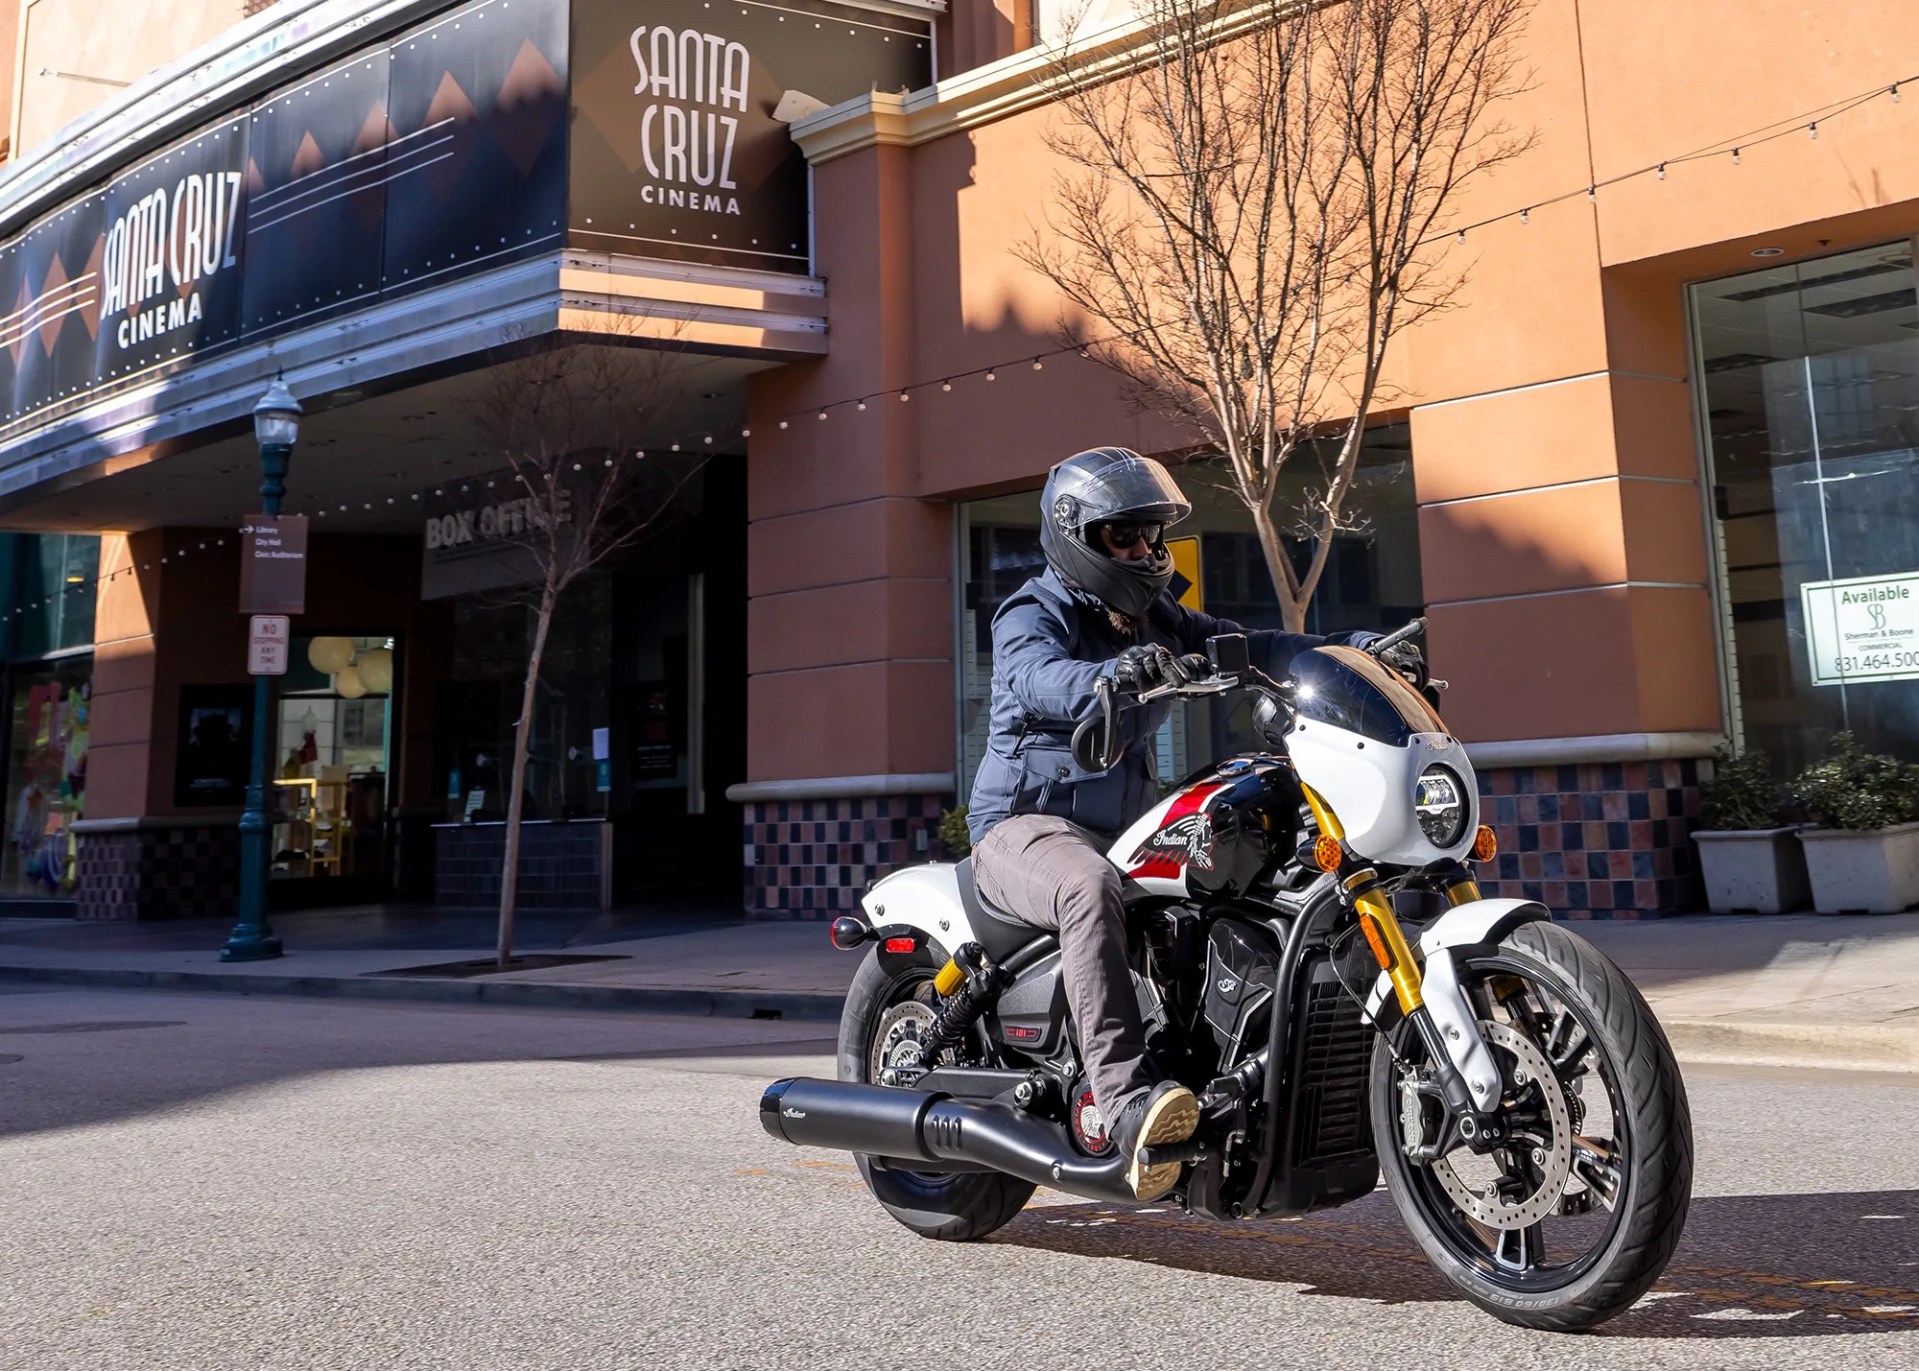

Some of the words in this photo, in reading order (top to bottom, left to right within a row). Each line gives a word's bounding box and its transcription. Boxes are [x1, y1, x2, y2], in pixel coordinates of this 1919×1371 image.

[629, 26, 750, 112] SANTA
[641, 104, 738, 190] CRUZ
[641, 185, 741, 215] CINEMA
[100, 187, 167, 320] SANTA
[170, 171, 242, 287] CRUZ
[117, 292, 203, 349] CINEMA
[255, 526, 278, 535] Library
[255, 538, 268, 546] City
[426, 511, 476, 549] BOX
[1841, 585, 1910, 604] Available
[262, 624, 277, 635] NO
[1844, 632, 1879, 640] Sherman
[1889, 628, 1914, 636] Boone
[1153, 830, 1188, 846] Indian
